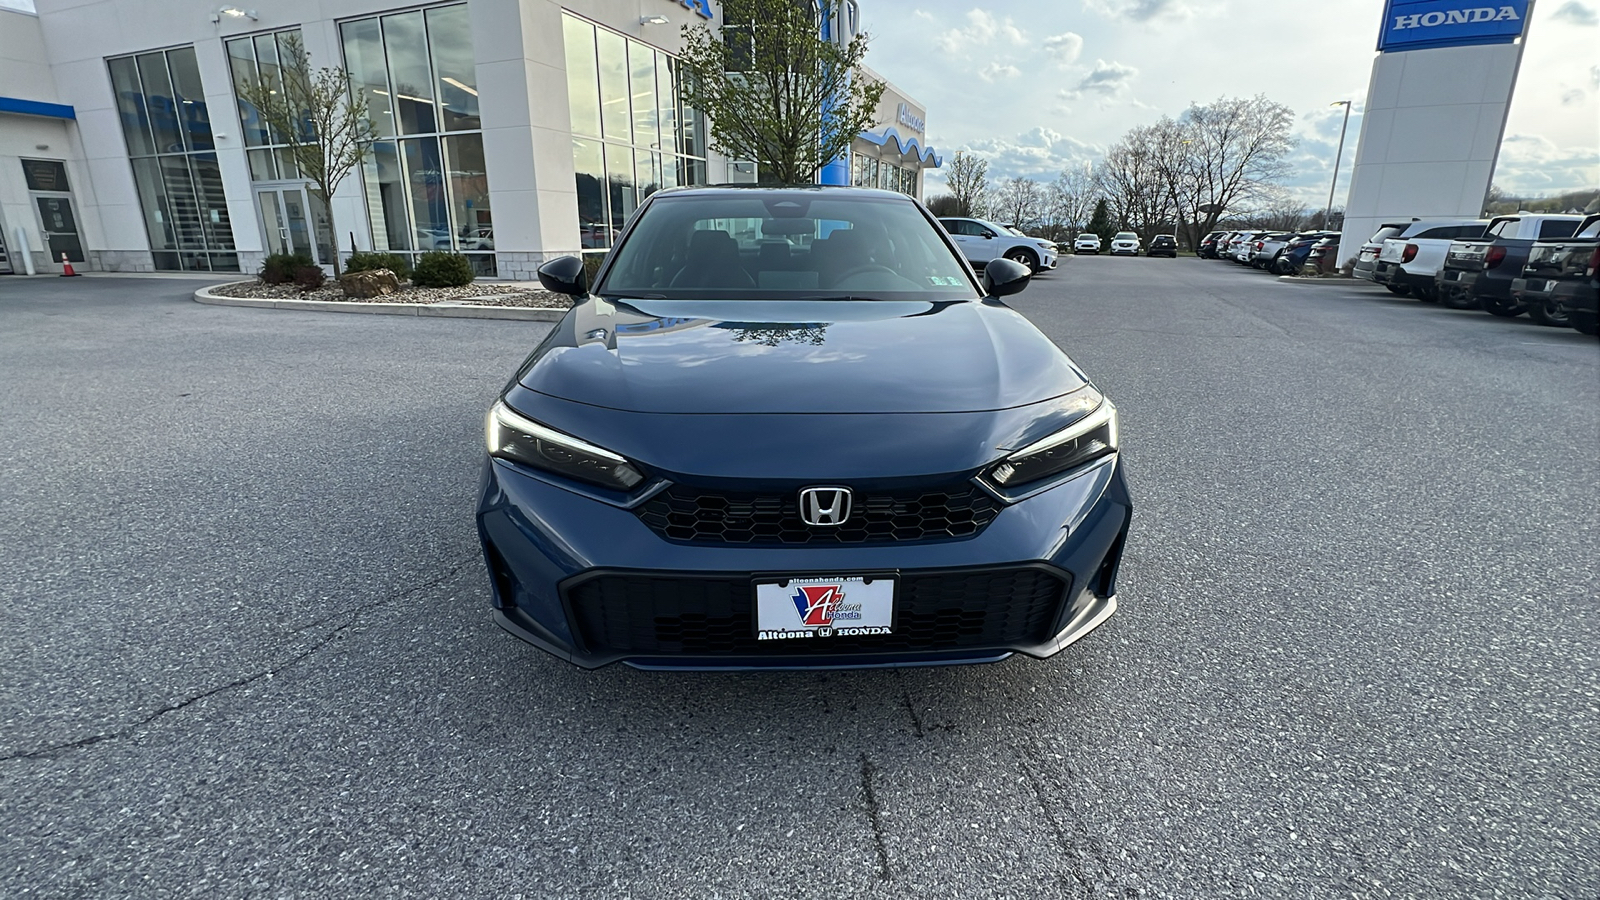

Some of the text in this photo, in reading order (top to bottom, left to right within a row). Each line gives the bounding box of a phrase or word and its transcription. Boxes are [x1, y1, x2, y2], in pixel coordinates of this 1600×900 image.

[1393, 6, 1520, 30] HONDA
[789, 576, 863, 584] altoonahonda.com
[805, 589, 861, 621] Altoona
[827, 611, 860, 620] Honda
[758, 631, 814, 640] Altoona
[837, 627, 892, 636] HONDA
